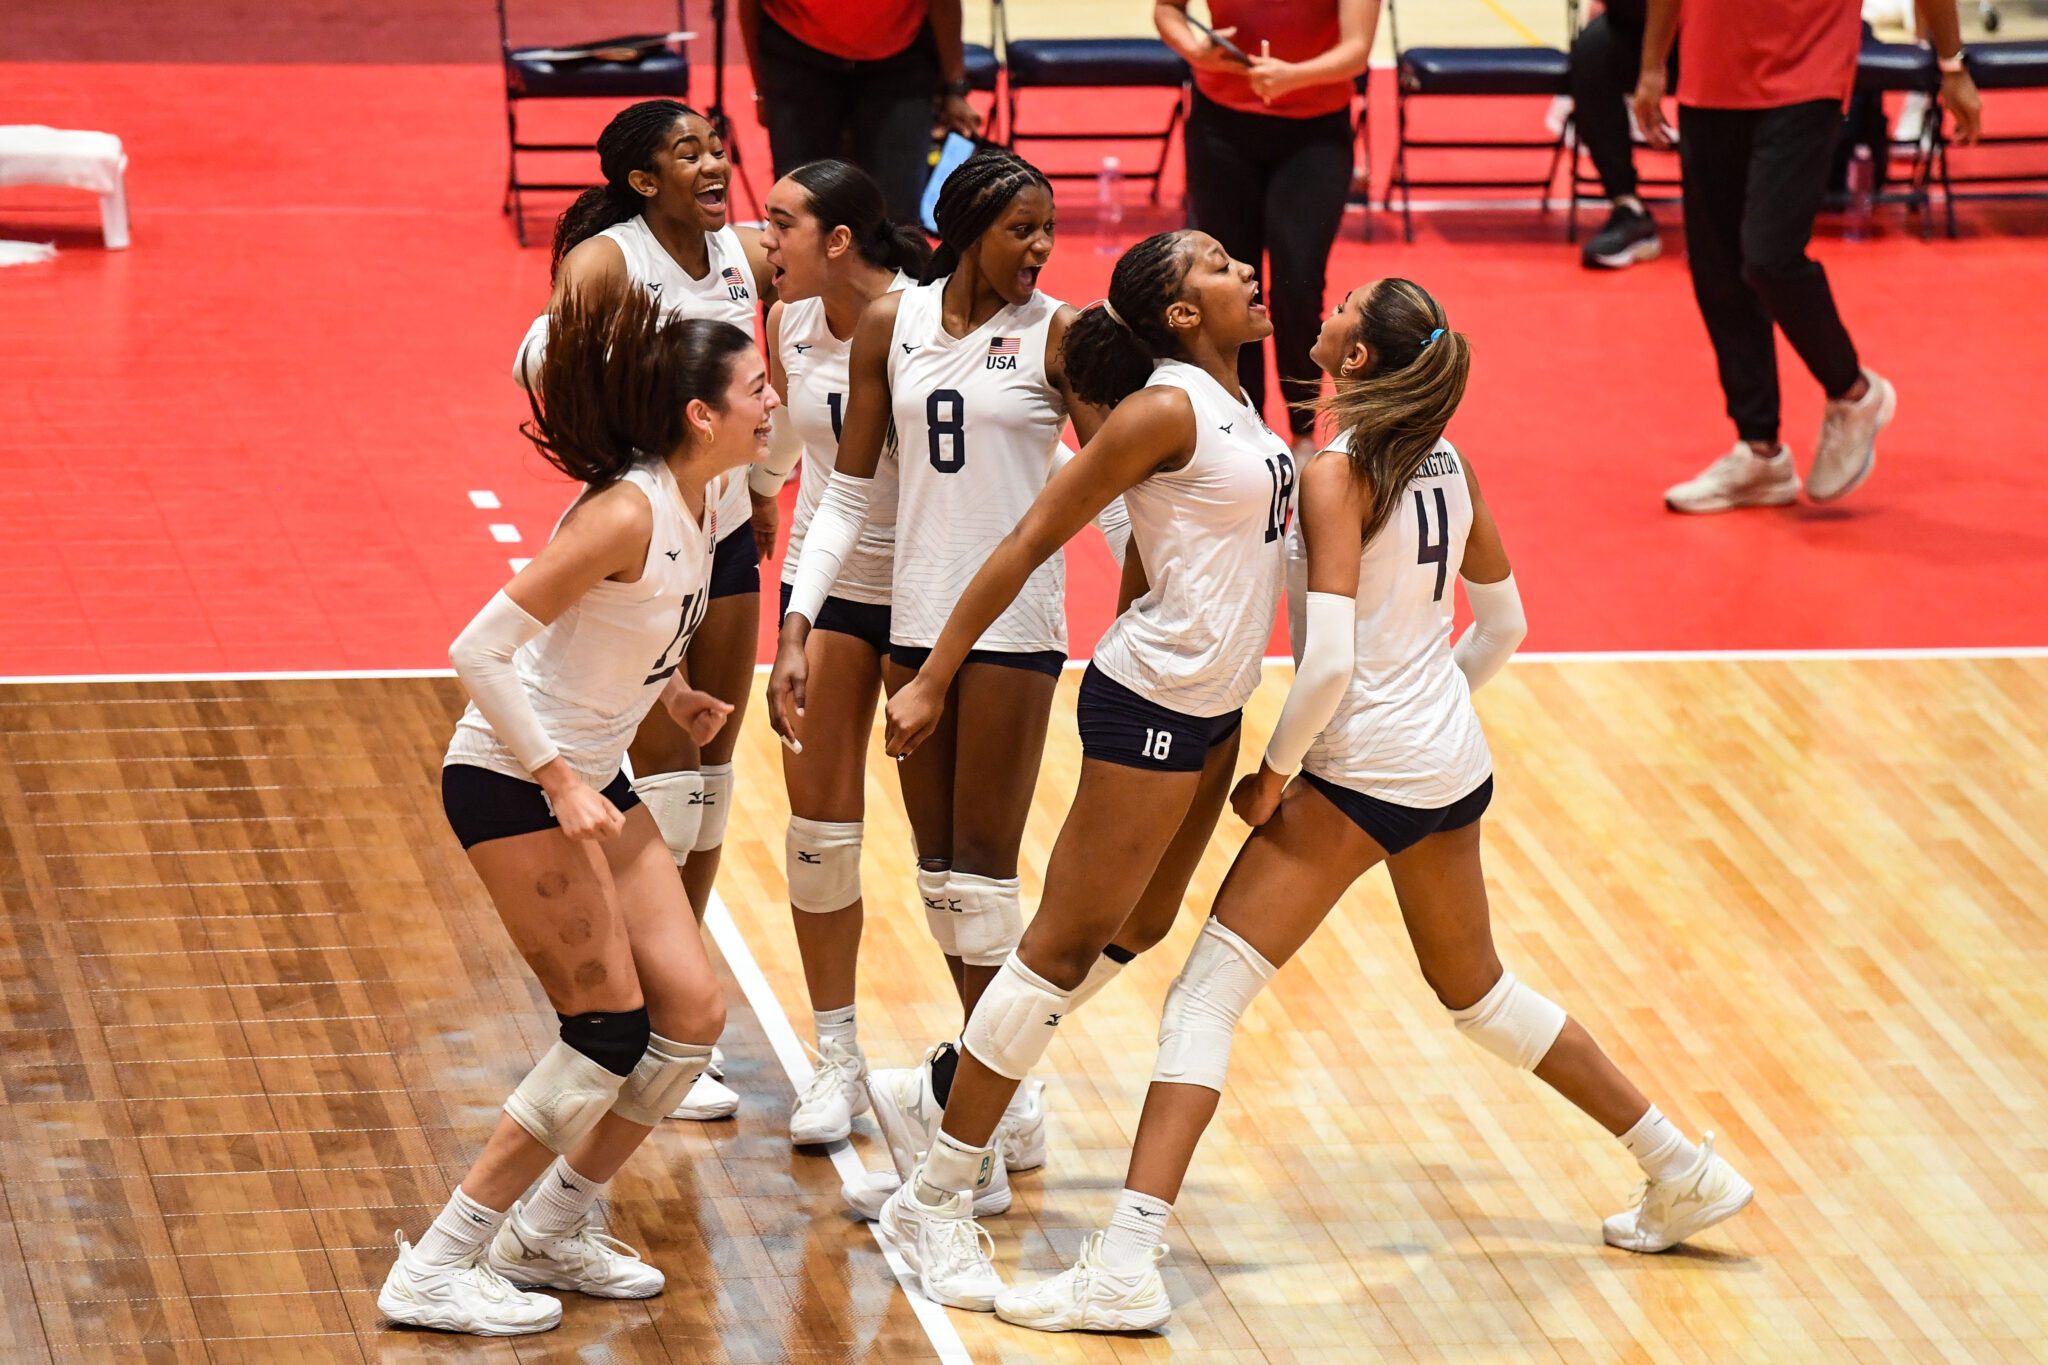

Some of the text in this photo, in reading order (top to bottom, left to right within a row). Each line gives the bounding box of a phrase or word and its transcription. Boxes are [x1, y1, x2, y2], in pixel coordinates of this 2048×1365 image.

[986, 355, 1017, 370] USA
[926, 389, 966, 474] 8
[1417, 451, 1459, 478] NGTON
[1265, 452, 1295, 544] 18
[1414, 487, 1449, 602] 4
[652, 580, 709, 670] 14
[1141, 727, 1173, 760] 18
